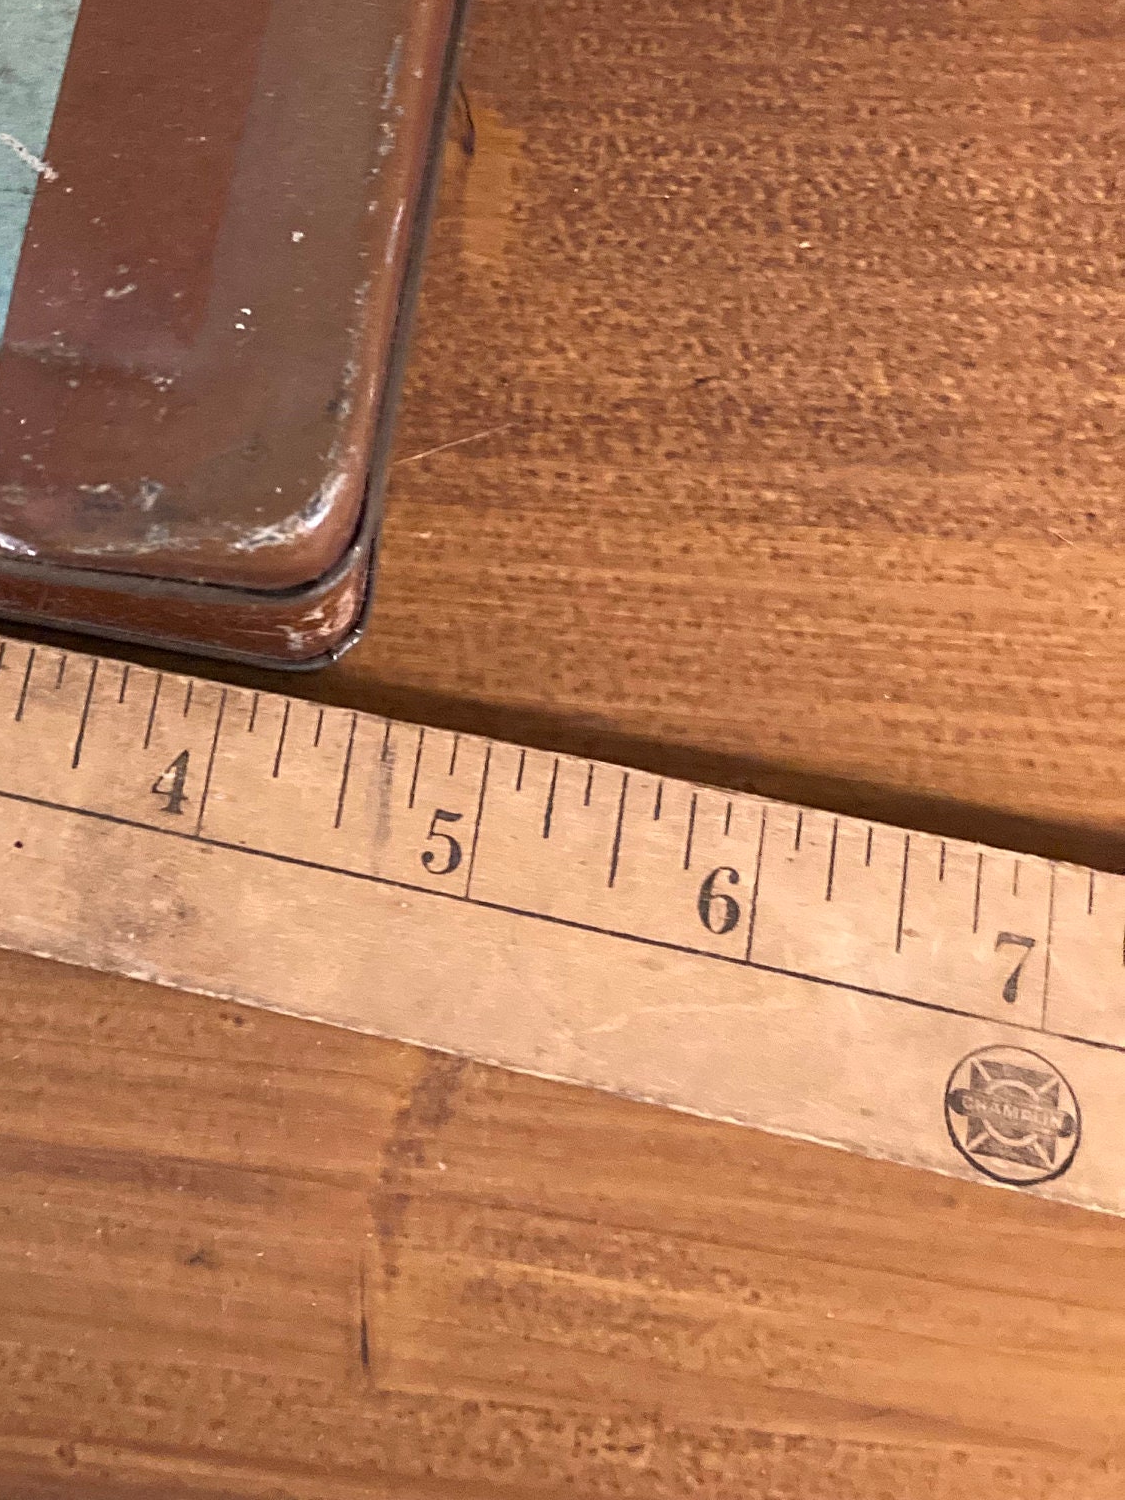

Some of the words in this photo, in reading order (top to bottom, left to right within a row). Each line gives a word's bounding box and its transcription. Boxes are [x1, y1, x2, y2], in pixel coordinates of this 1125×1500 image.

[151, 749, 190, 816] 4
[420, 807, 465, 875] 5
[698, 866, 742, 935] 6
[994, 932, 1037, 1004] 7
